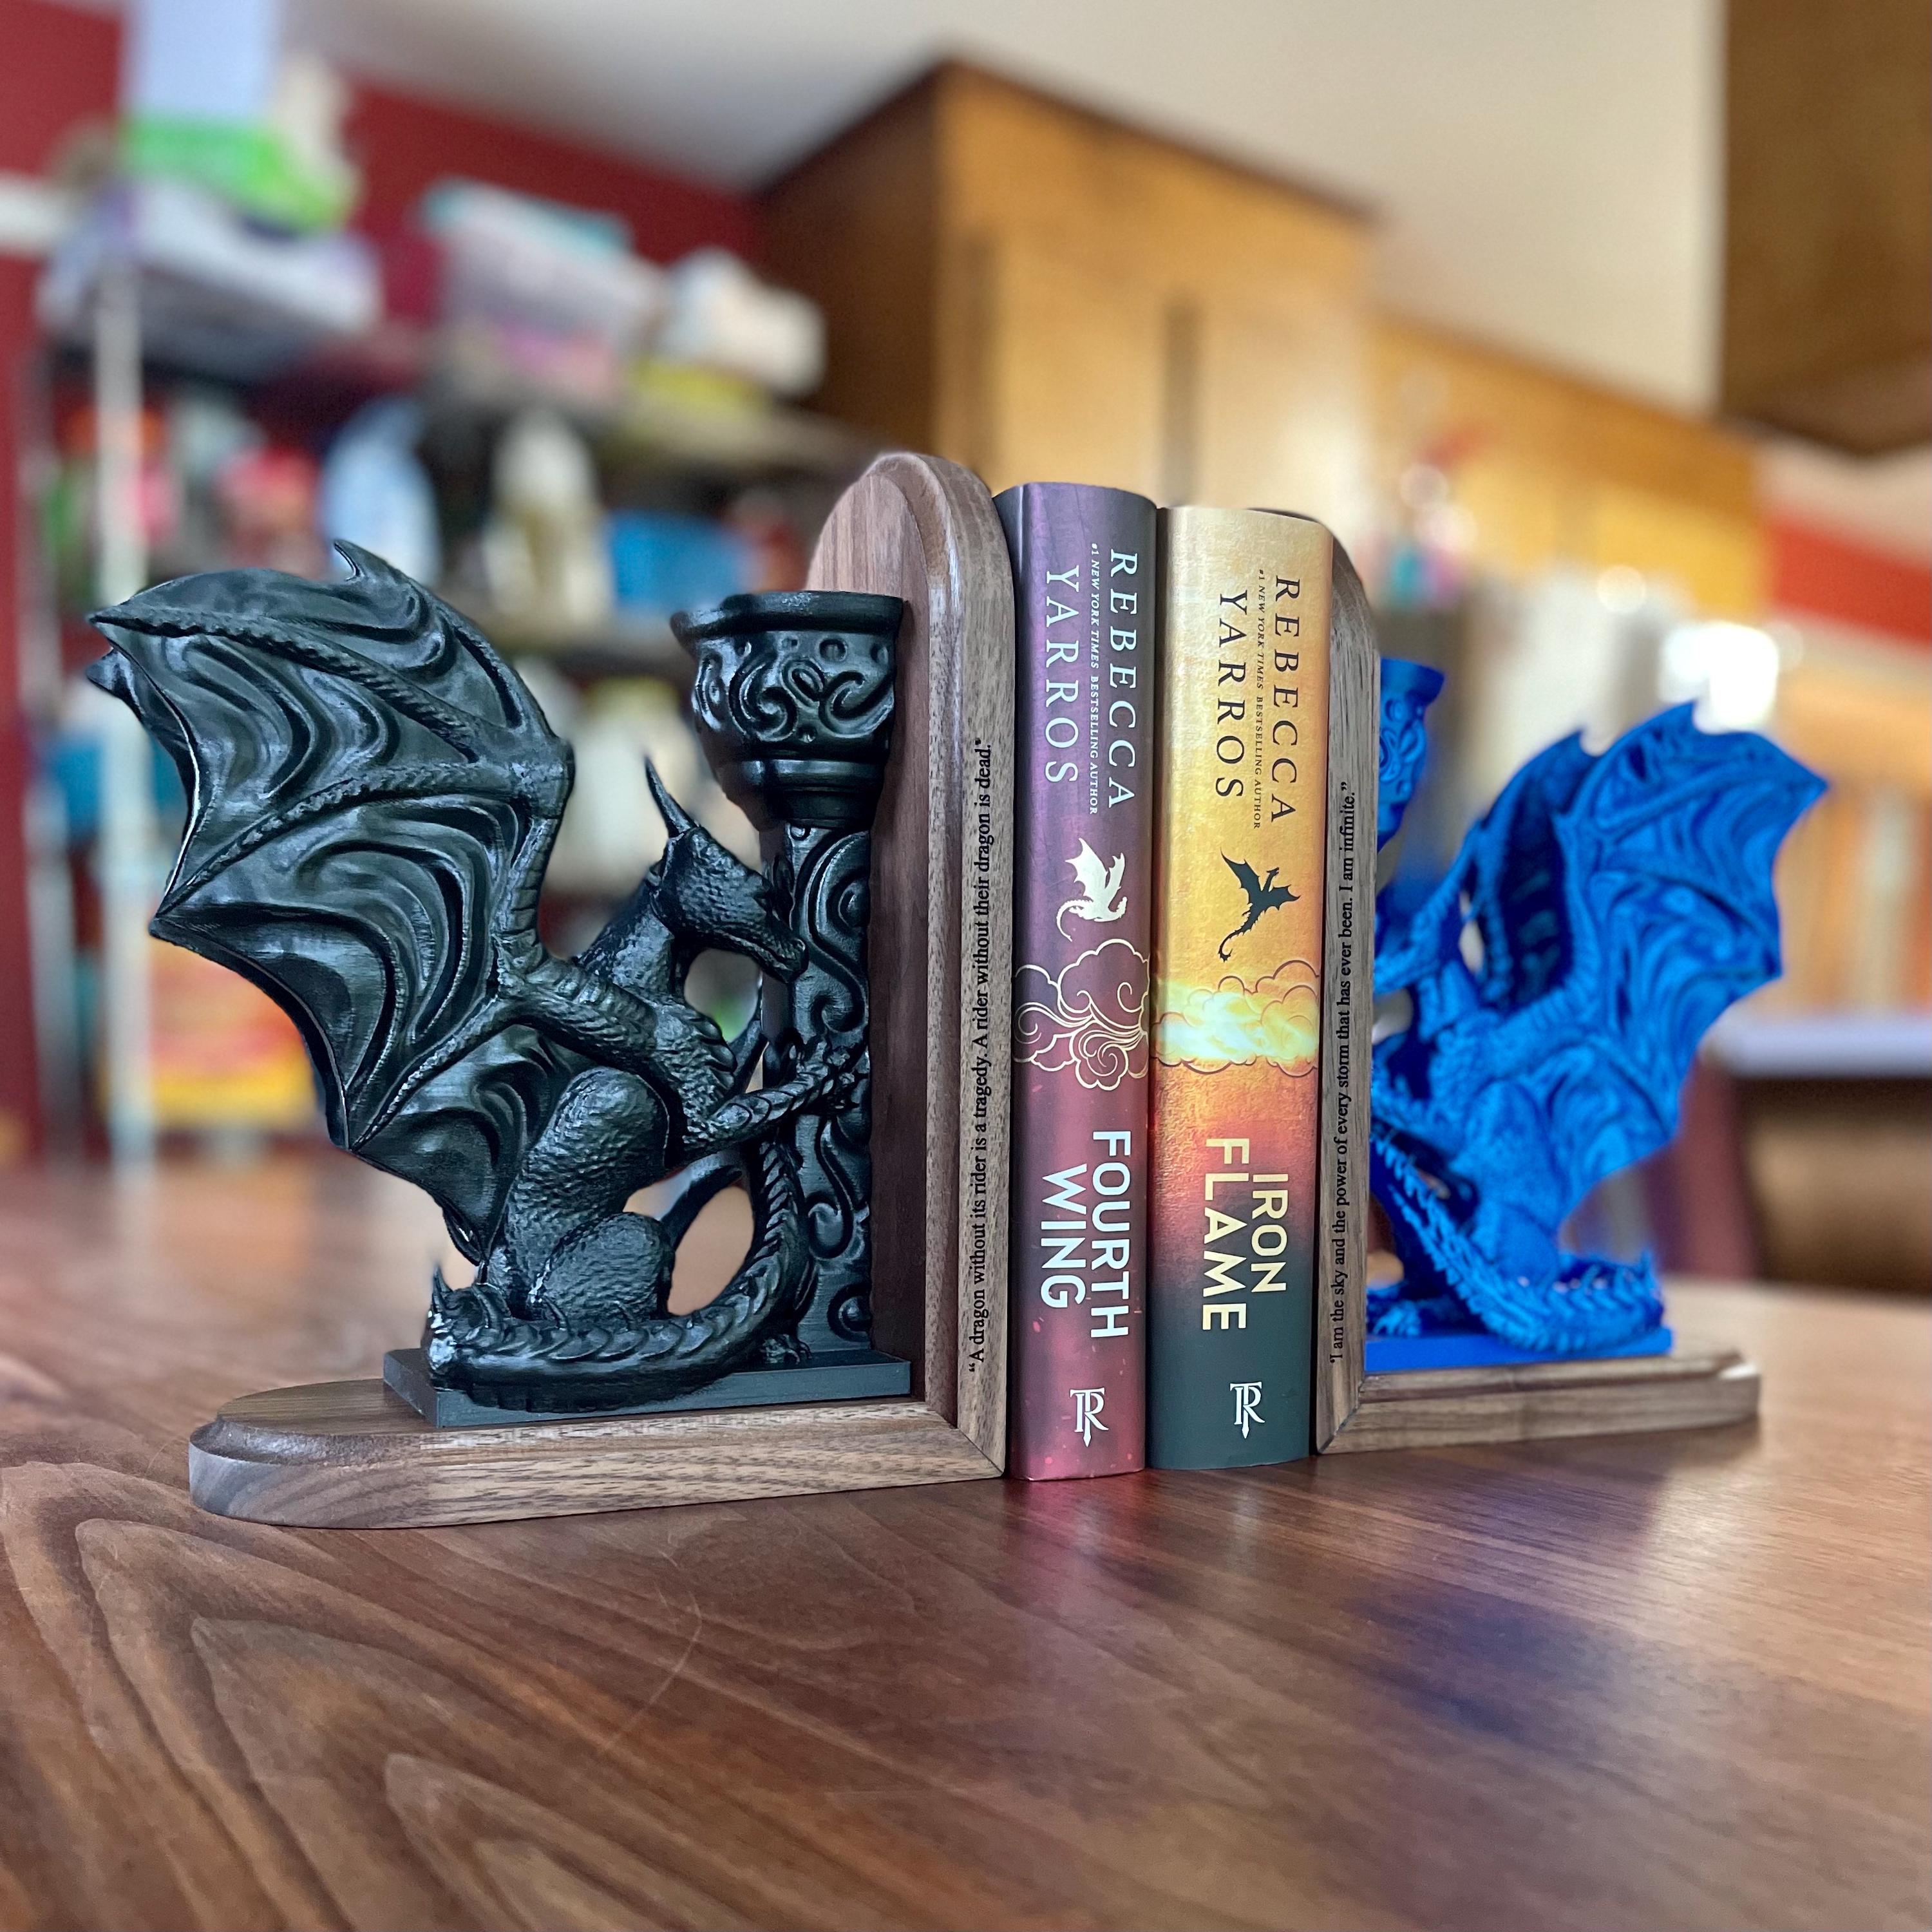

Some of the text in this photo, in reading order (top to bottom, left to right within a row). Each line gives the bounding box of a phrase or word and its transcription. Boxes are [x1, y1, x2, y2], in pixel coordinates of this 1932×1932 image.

[1045, 564, 1080, 783] YARROS
[1089, 542, 1100, 815] #1 NEW YORK TIMES BESTSELLING AUTHOR
[1108, 549, 1138, 808] REBECCA
[1215, 589, 1248, 798] YARROS
[1253, 569, 1266, 829] #1 NEW YORK TIMES BESTSELLING AUTHOR
[1270, 574, 1301, 823] REBECCA
[974, 794, 990, 807] is
[974, 813, 994, 872] dragon
[1343, 858, 1353, 881] am
[973, 877, 990, 916] their
[1338, 897, 1352, 938] been.
[972, 921, 989, 985] without
[1340, 942, 1352, 976] ever
[972, 990, 988, 1030] rider
[1336, 981, 1350, 1005] has
[972, 1034, 988, 1048] A
[1336, 1010, 1350, 1039] that
[971, 1054, 992, 1118] tragedy.
[1336, 1045, 1349, 1088] storm
[975, 1123, 987, 1133] a
[1338, 1092, 1352, 1135] every
[971, 1137, 987, 1151] is
[1334, 1137, 1347, 1155] of
[970, 1155, 986, 1196] rider
[1336, 1159, 1350, 1206] power
[970, 1200, 986, 1218] its
[1332, 1211, 1345, 1234] the
[1040, 1163, 1087, 1309] WING
[1090, 1130, 1132, 1338] FOURTH
[1202, 1138, 1250, 1331] FLAME
[1251, 1173, 1289, 1293] IRON
[1332, 1238, 1345, 1265] and
[969, 1224, 985, 1285] without
[1331, 1271, 1348, 1295] sky
[969, 1289, 989, 1345] dragon
[1330, 1300, 1344, 1322] the
[1333, 1327, 1343, 1349] am
